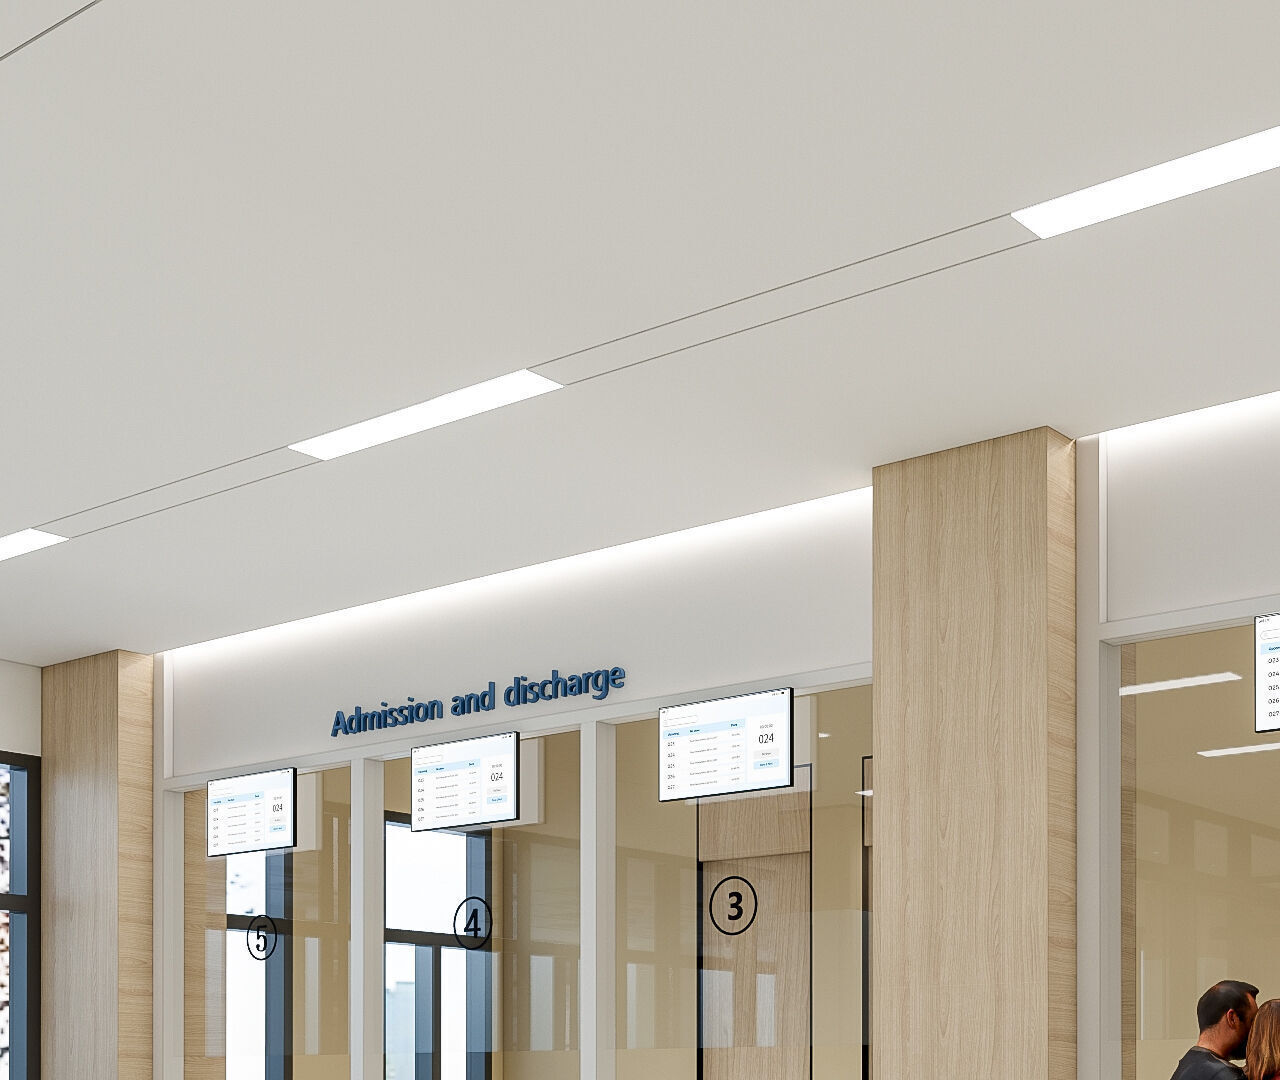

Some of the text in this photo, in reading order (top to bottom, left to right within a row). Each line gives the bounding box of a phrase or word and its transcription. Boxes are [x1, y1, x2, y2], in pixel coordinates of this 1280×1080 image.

[330, 666, 626, 737] Admission and discharge
[758, 732, 774, 744] 024
[490, 771, 503, 782] 024
[728, 891, 743, 920] 3
[463, 908, 481, 938] 4
